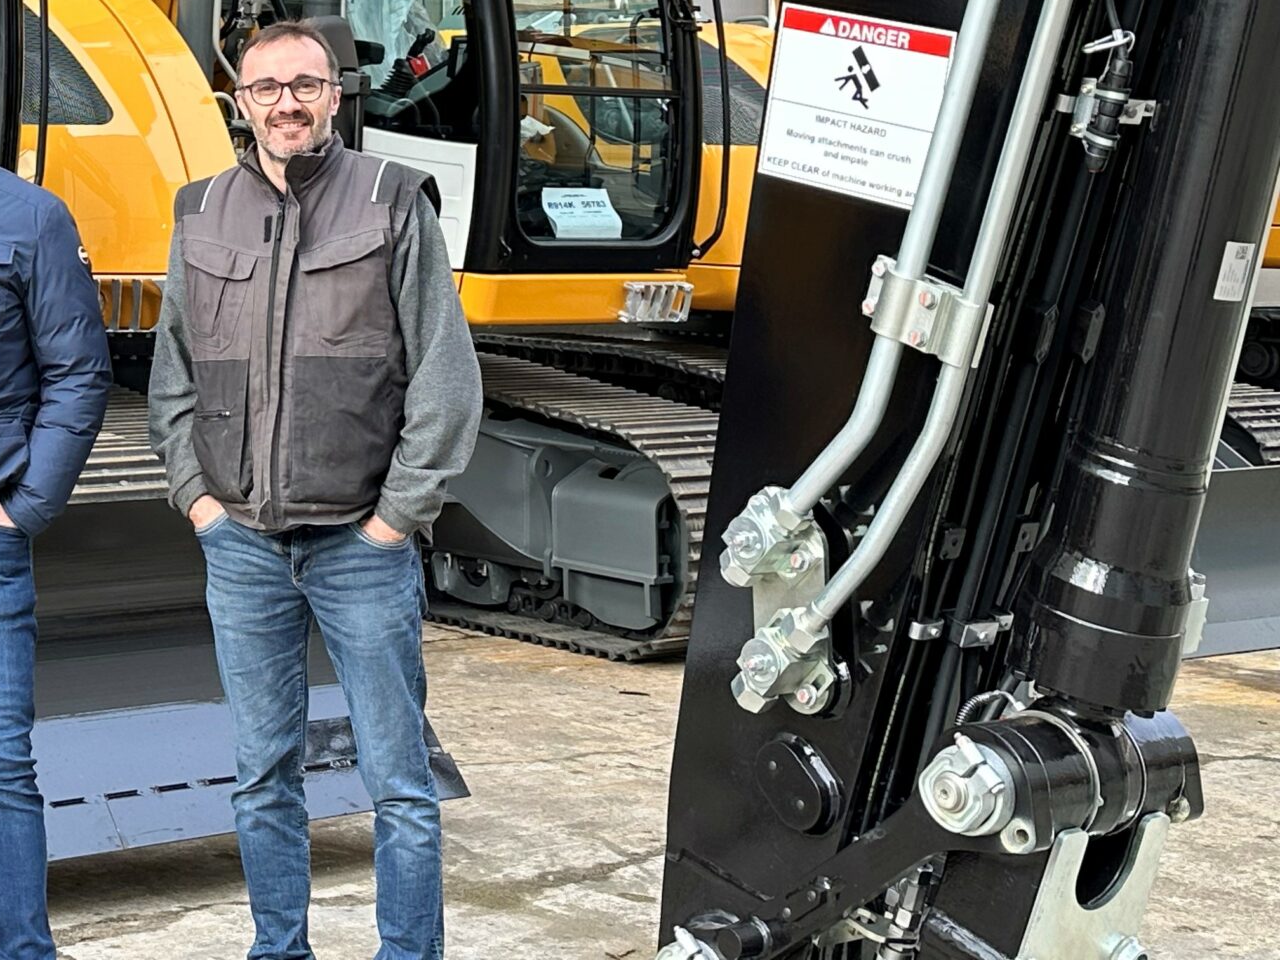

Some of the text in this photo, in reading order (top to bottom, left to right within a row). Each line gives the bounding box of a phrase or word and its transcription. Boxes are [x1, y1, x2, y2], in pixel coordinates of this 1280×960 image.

[837, 20, 911, 49] DANGER
[814, 115, 887, 138] IMPACT HAZARD
[786, 128, 912, 164] Moving attachments can crush
[823, 150, 869, 167] and impale
[766, 156, 789, 168] KEEP
[791, 161, 820, 176] CLEAR
[821, 168, 831, 178] of
[831, 172, 867, 187] machine
[868, 179, 903, 198] working
